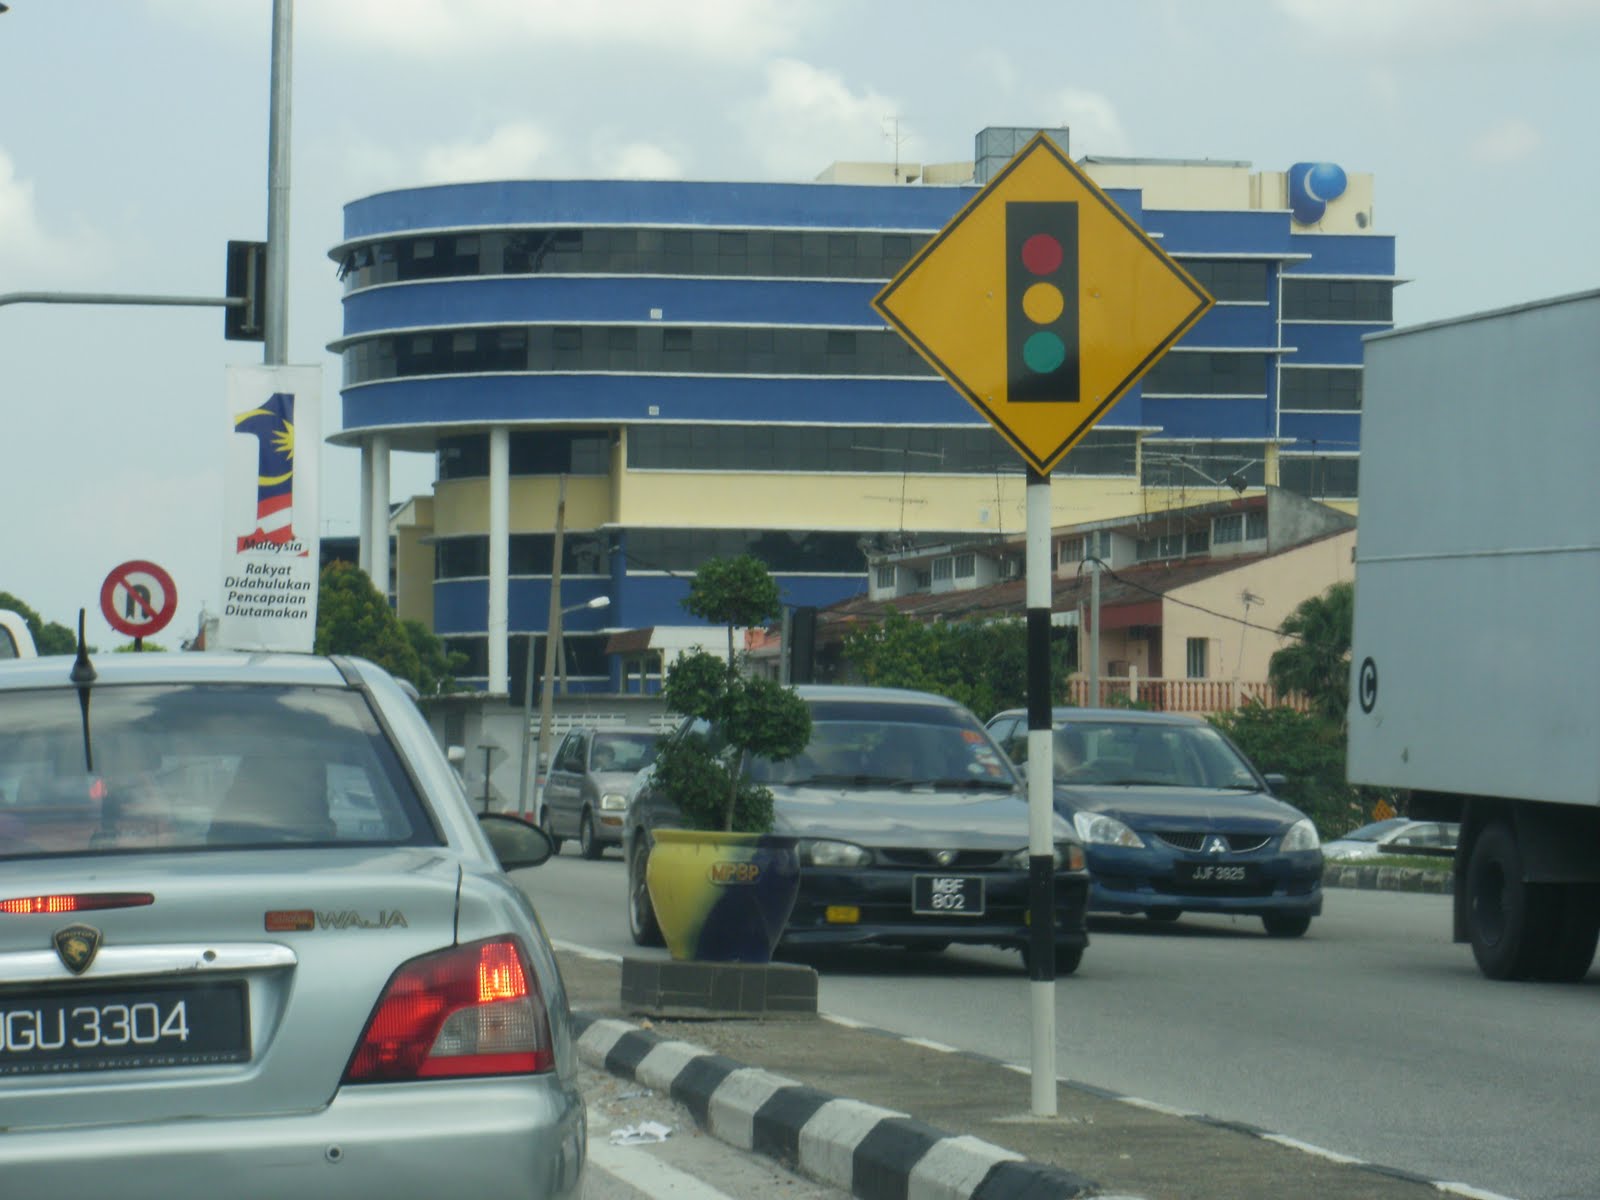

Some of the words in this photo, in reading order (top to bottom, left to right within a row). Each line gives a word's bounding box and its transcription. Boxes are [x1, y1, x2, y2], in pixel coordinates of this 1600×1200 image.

[242, 537, 302, 553] Malaysia
[245, 562, 292, 577] Rakyat
[224, 576, 311, 590] Didahulukan
[228, 590, 306, 606] Pencapaian
[224, 604, 309, 619] Diutamakan
[932, 878, 965, 893] MBF
[931, 893, 966, 909] 802
[71, 1000, 190, 1048] 3304
